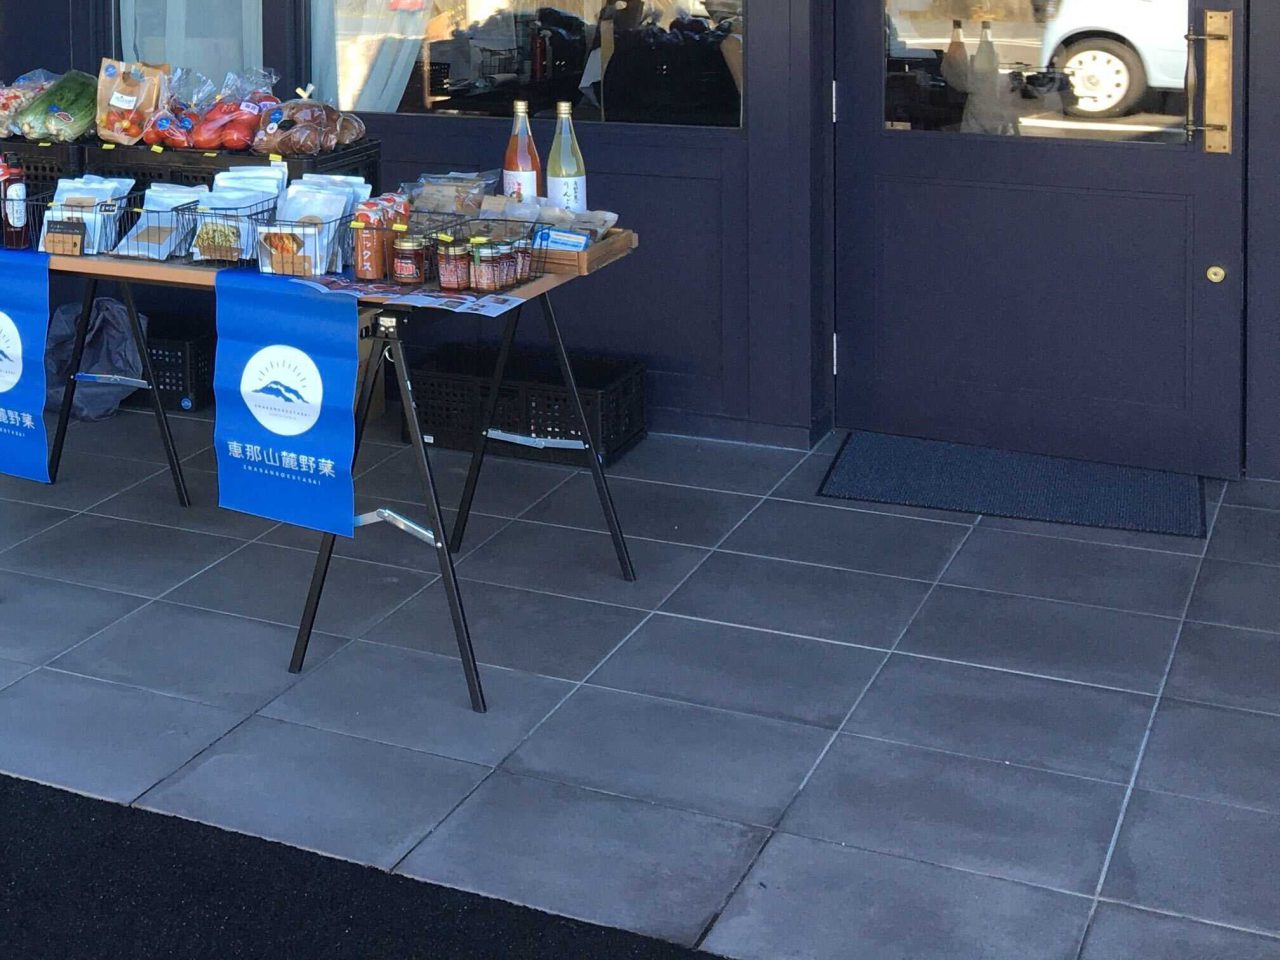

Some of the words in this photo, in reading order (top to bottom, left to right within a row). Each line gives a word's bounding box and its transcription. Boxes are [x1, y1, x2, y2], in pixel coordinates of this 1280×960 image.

[226, 439, 336, 479] 恵那山麓野菜
